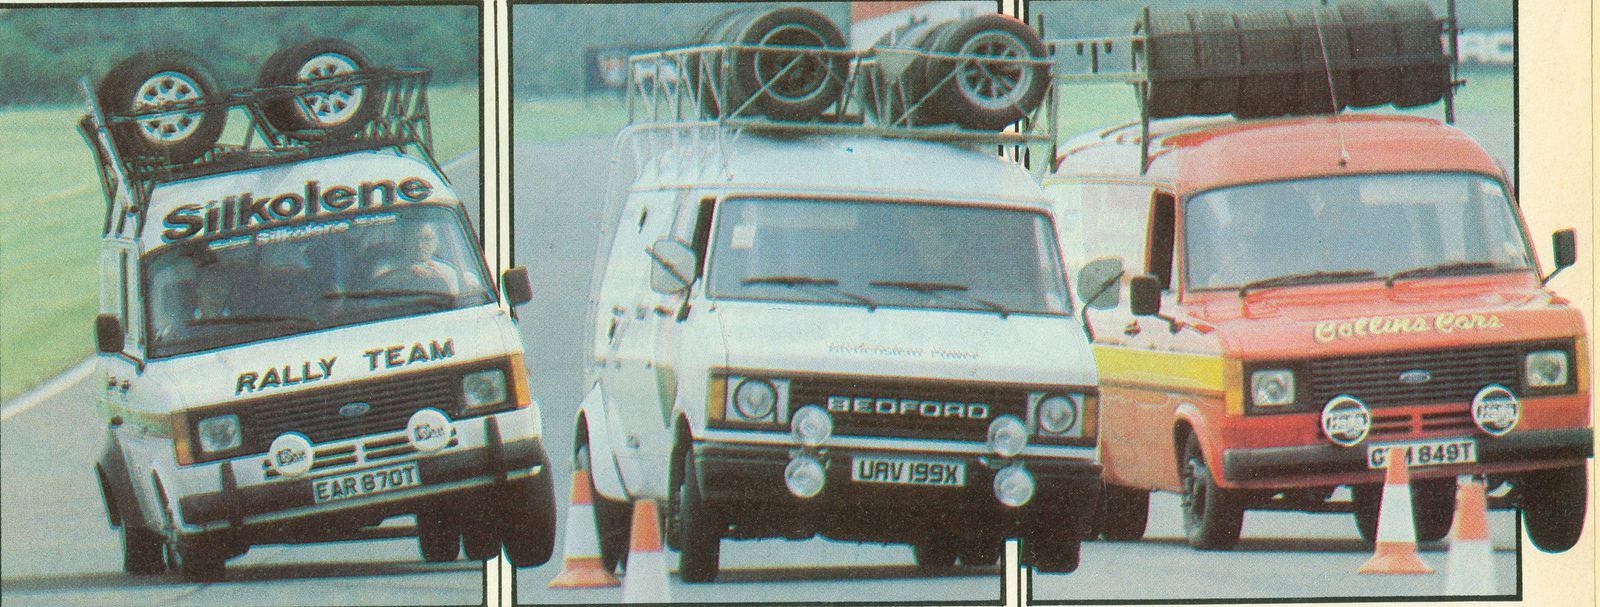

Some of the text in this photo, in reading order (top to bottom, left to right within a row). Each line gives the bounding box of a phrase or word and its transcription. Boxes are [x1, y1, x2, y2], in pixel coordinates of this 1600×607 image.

[161, 176, 434, 243] Silkolene
[1313, 312, 1504, 344] Collins Cars
[235, 338, 455, 396] RALLY TEAM
[827, 396, 990, 419] BEDFORD
[1418, 442, 1472, 464] 849T
[314, 465, 416, 501] EAR 870T
[859, 459, 959, 484] UAV 199X
